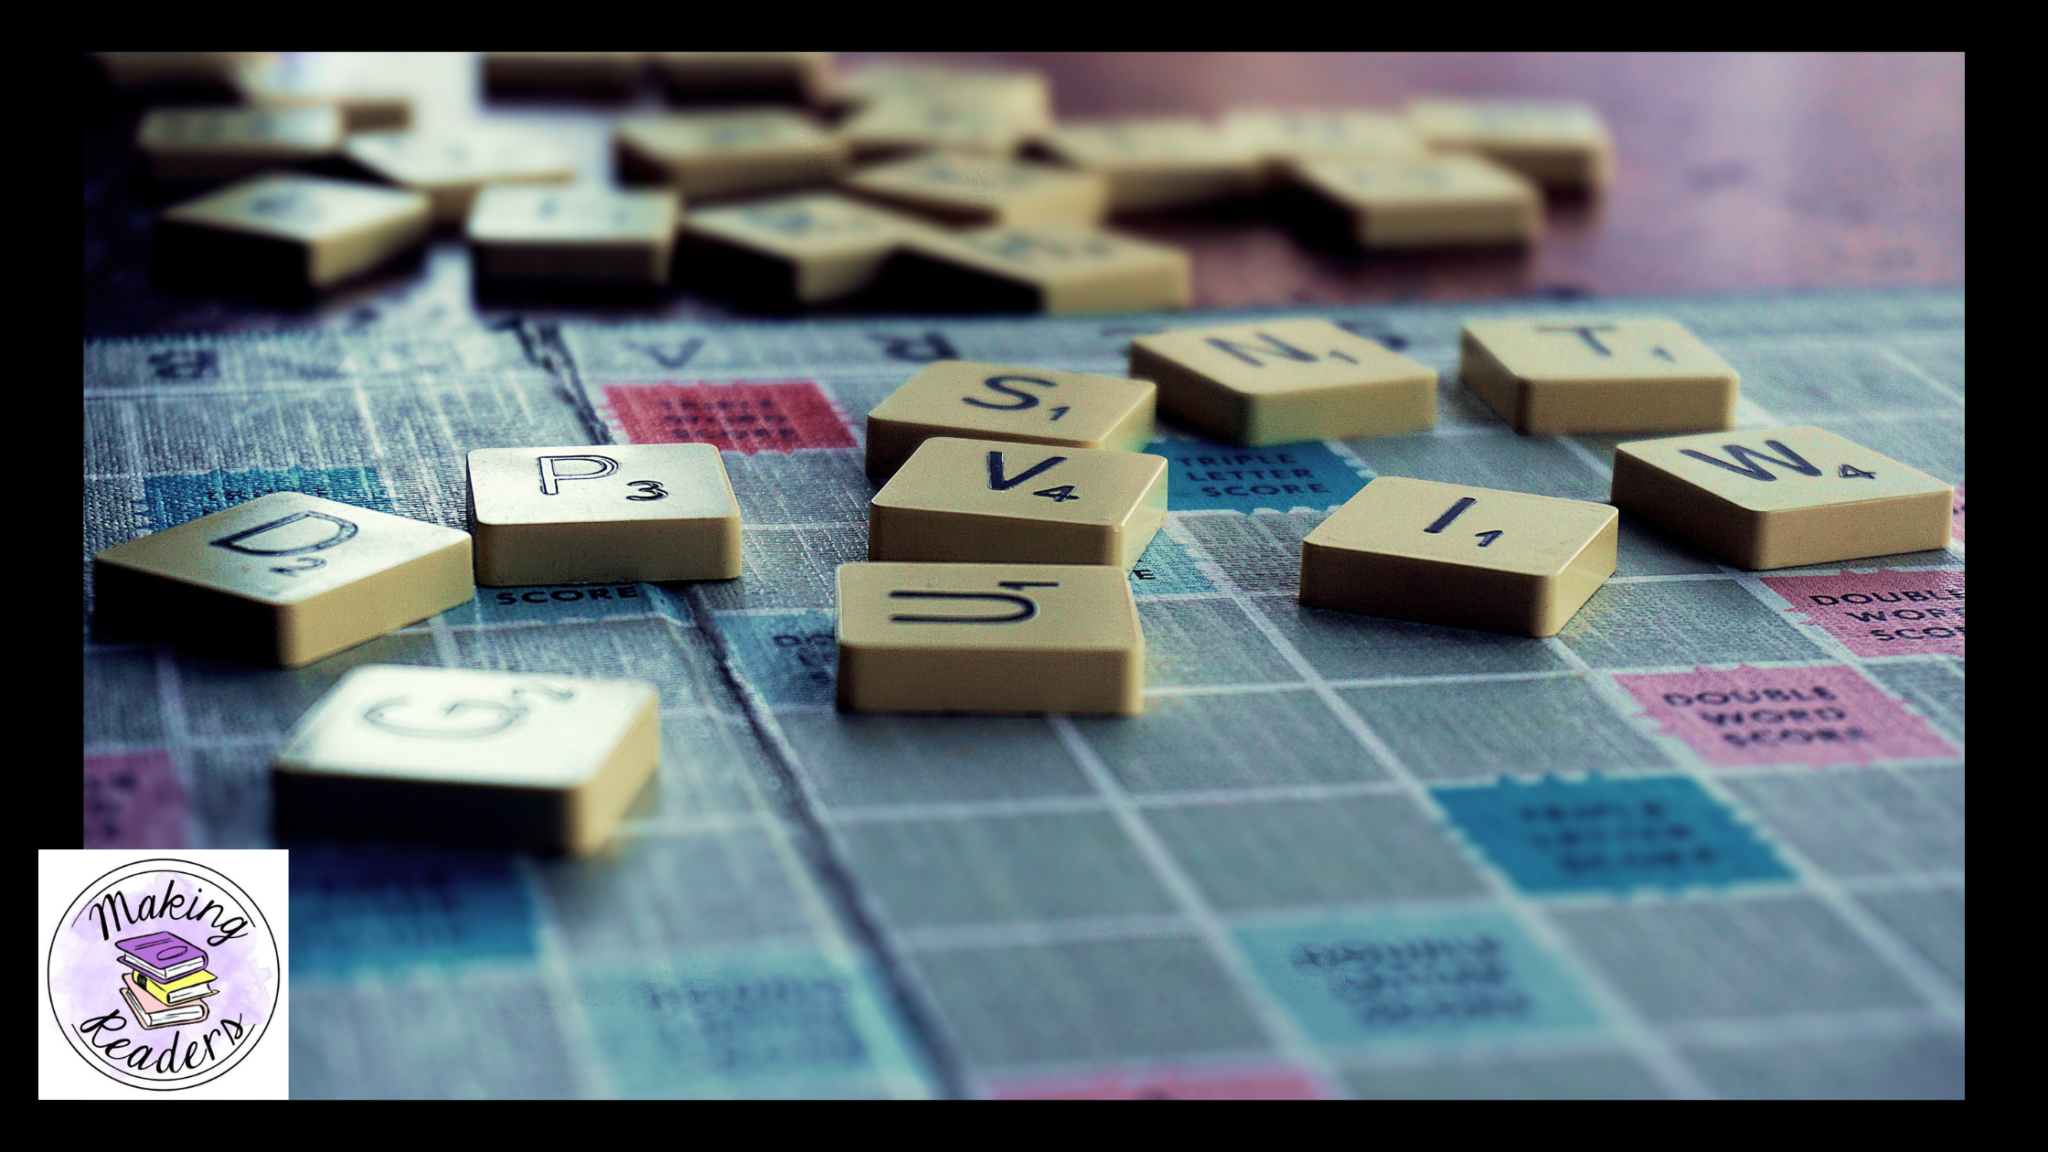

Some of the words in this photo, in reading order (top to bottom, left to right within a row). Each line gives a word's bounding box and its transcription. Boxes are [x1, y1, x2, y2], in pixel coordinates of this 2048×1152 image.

[1204, 332, 1319, 368] N
[1533, 324, 1617, 357] T
[961, 375, 1058, 411] S
[1048, 405, 1071, 421] 1
[985, 450, 1068, 491] V
[1032, 485, 1080, 503] 4
[1173, 453, 1298, 467] TRIPLE
[1185, 469, 1315, 482] LETTER
[1679, 439, 1823, 483] W
[1836, 463, 1877, 481] 4
[538, 454, 619, 496] P
[625, 479, 670, 501] 3
[1201, 483, 1331, 497] SCORE
[208, 509, 360, 557] D
[1474, 529, 1504, 548] 1
[495, 586, 640, 605] SCORE
[888, 589, 1038, 624] U
[1661, 686, 1837, 707] DOUBLE
[362, 696, 529, 740] G
[1698, 706, 1847, 726] WORD
